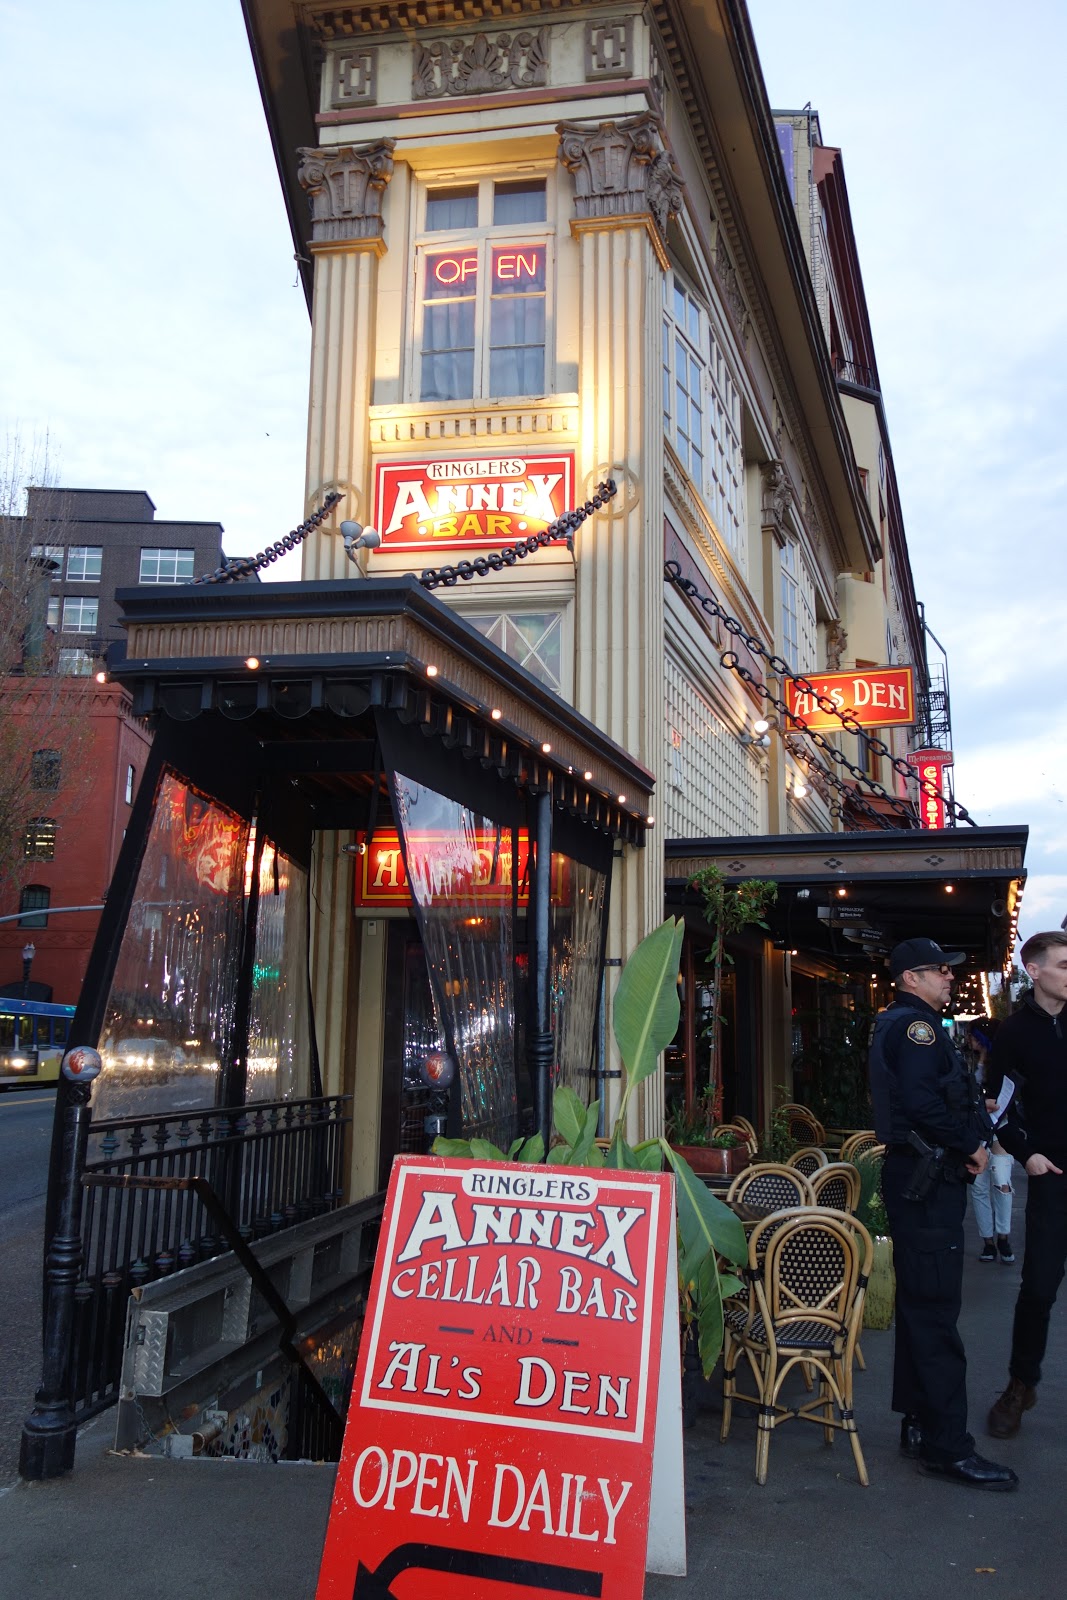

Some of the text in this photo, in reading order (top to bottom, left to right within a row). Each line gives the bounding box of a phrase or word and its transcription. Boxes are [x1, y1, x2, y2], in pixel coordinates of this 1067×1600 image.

[435, 254, 537, 283] OPEN
[432, 460, 523, 478] RINGLERS
[384, 474, 563, 536] ANNEX
[432, 513, 513, 537] BAR
[794, 679, 907, 718] AL'S DEN
[470, 1173, 592, 1201] RINGLERS
[397, 1191, 646, 1286] ANNEX
[391, 1255, 639, 1323] CELLAR BAR
[482, 1326, 534, 1346] AND
[377, 1340, 631, 1420] AL'S DEN
[352, 1445, 633, 1545] OPEN DAILY
